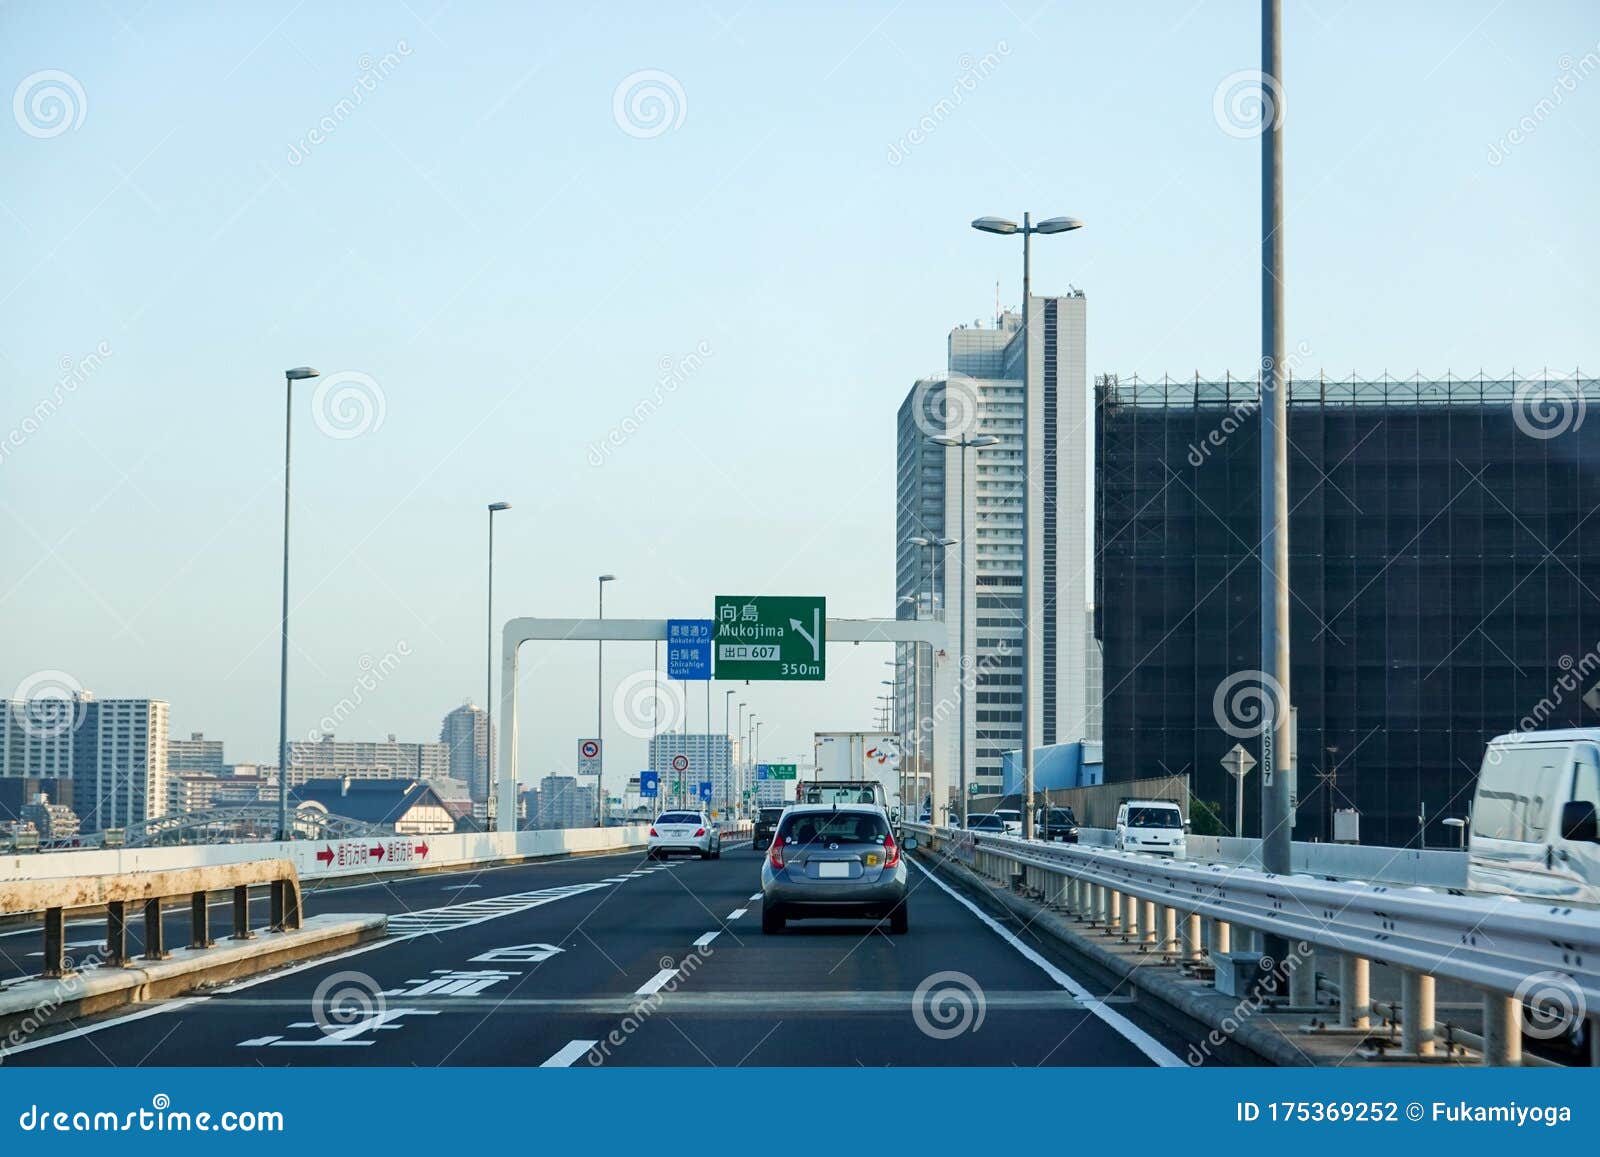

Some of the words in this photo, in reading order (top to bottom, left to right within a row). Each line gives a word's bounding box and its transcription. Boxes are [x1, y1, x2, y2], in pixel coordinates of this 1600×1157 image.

[720, 604, 759, 622] 向島
[720, 624, 784, 640] Mukojima
[725, 646, 747, 658] 出口
[752, 647, 776, 658] 607
[781, 663, 820, 675] 350m
